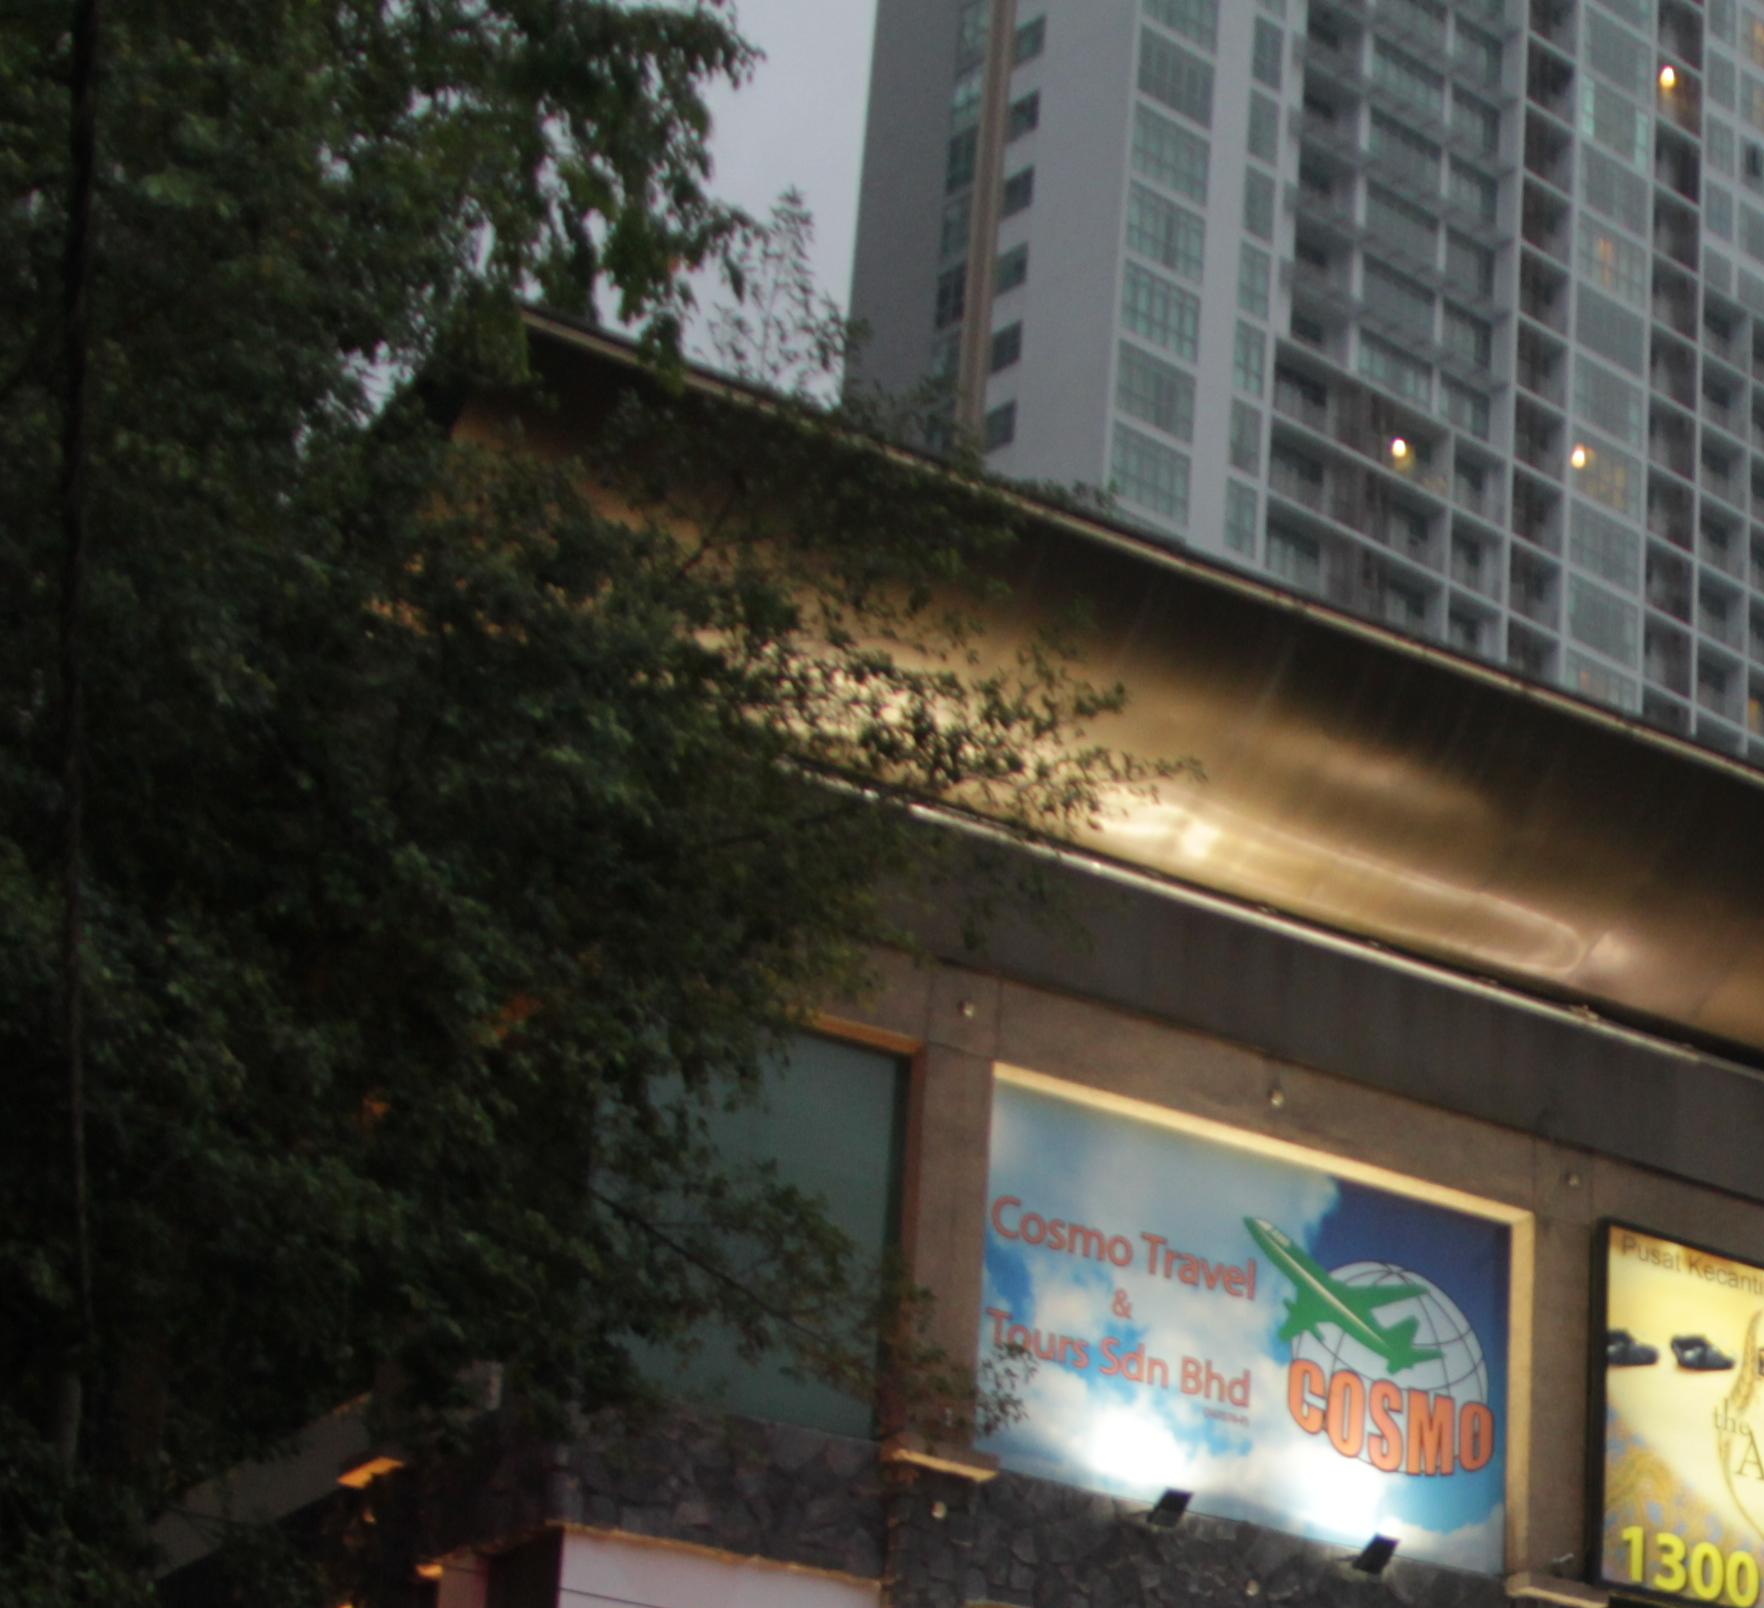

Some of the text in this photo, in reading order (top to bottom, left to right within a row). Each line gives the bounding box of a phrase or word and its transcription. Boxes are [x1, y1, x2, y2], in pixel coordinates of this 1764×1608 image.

[991, 1195, 1257, 1301] Cosmo Travel
[1621, 1236, 1681, 1272] Pusat
[1111, 1289, 1132, 1319] &
[985, 1306, 1252, 1408] Tours Sdn Bhd
[1287, 1359, 1494, 1476] COSMO
[1713, 1398, 1752, 1436] the
